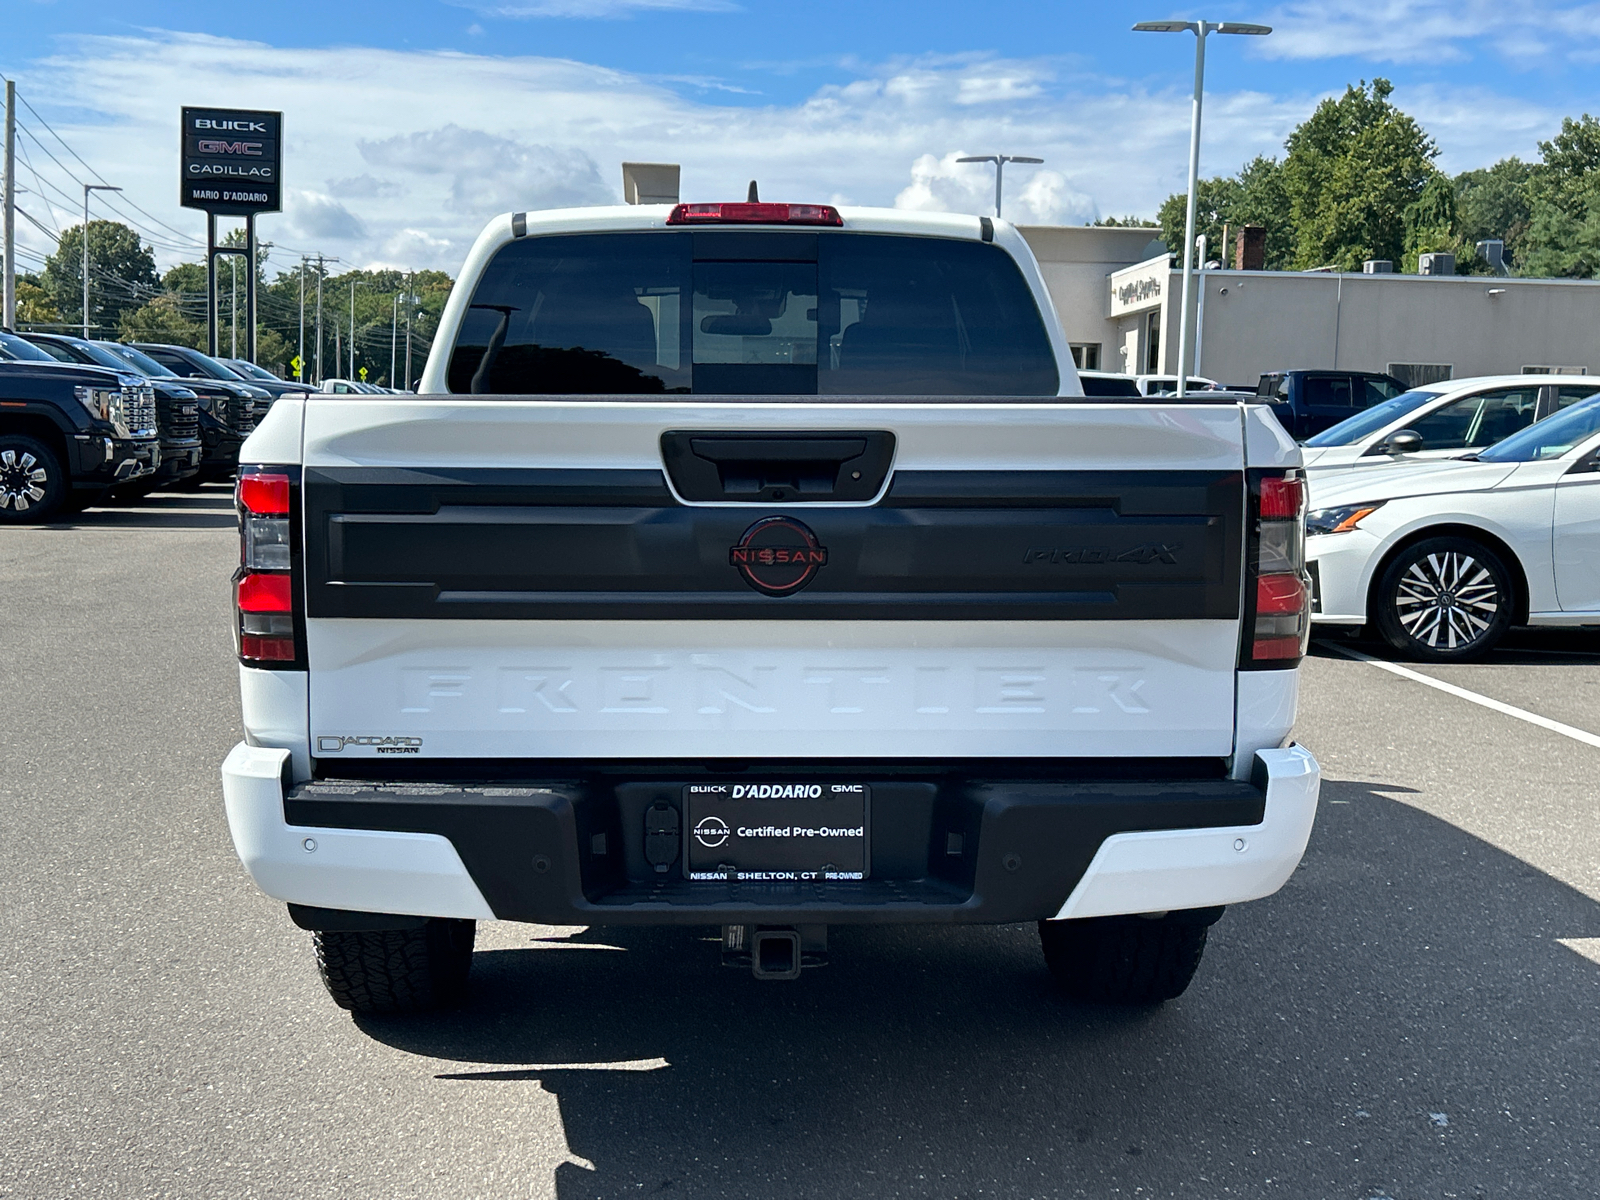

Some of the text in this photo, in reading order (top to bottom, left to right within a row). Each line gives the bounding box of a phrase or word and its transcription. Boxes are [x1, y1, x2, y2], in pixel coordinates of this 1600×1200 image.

[195, 119, 267, 132] BUICK
[198, 140, 263, 156] GMC
[189, 164, 272, 176] CADILLAC
[193, 189, 268, 202] MARIO D'ADDARIO
[733, 550, 823, 562] NISSAN
[399, 665, 1151, 714] FRONTIER
[690, 784, 863, 799] BUICK D'ADDARIO GMC
[737, 826, 864, 837] Certified Pre-Owned
[690, 872, 863, 881] NISSAN SHELTON, CT PRE-OWNED
